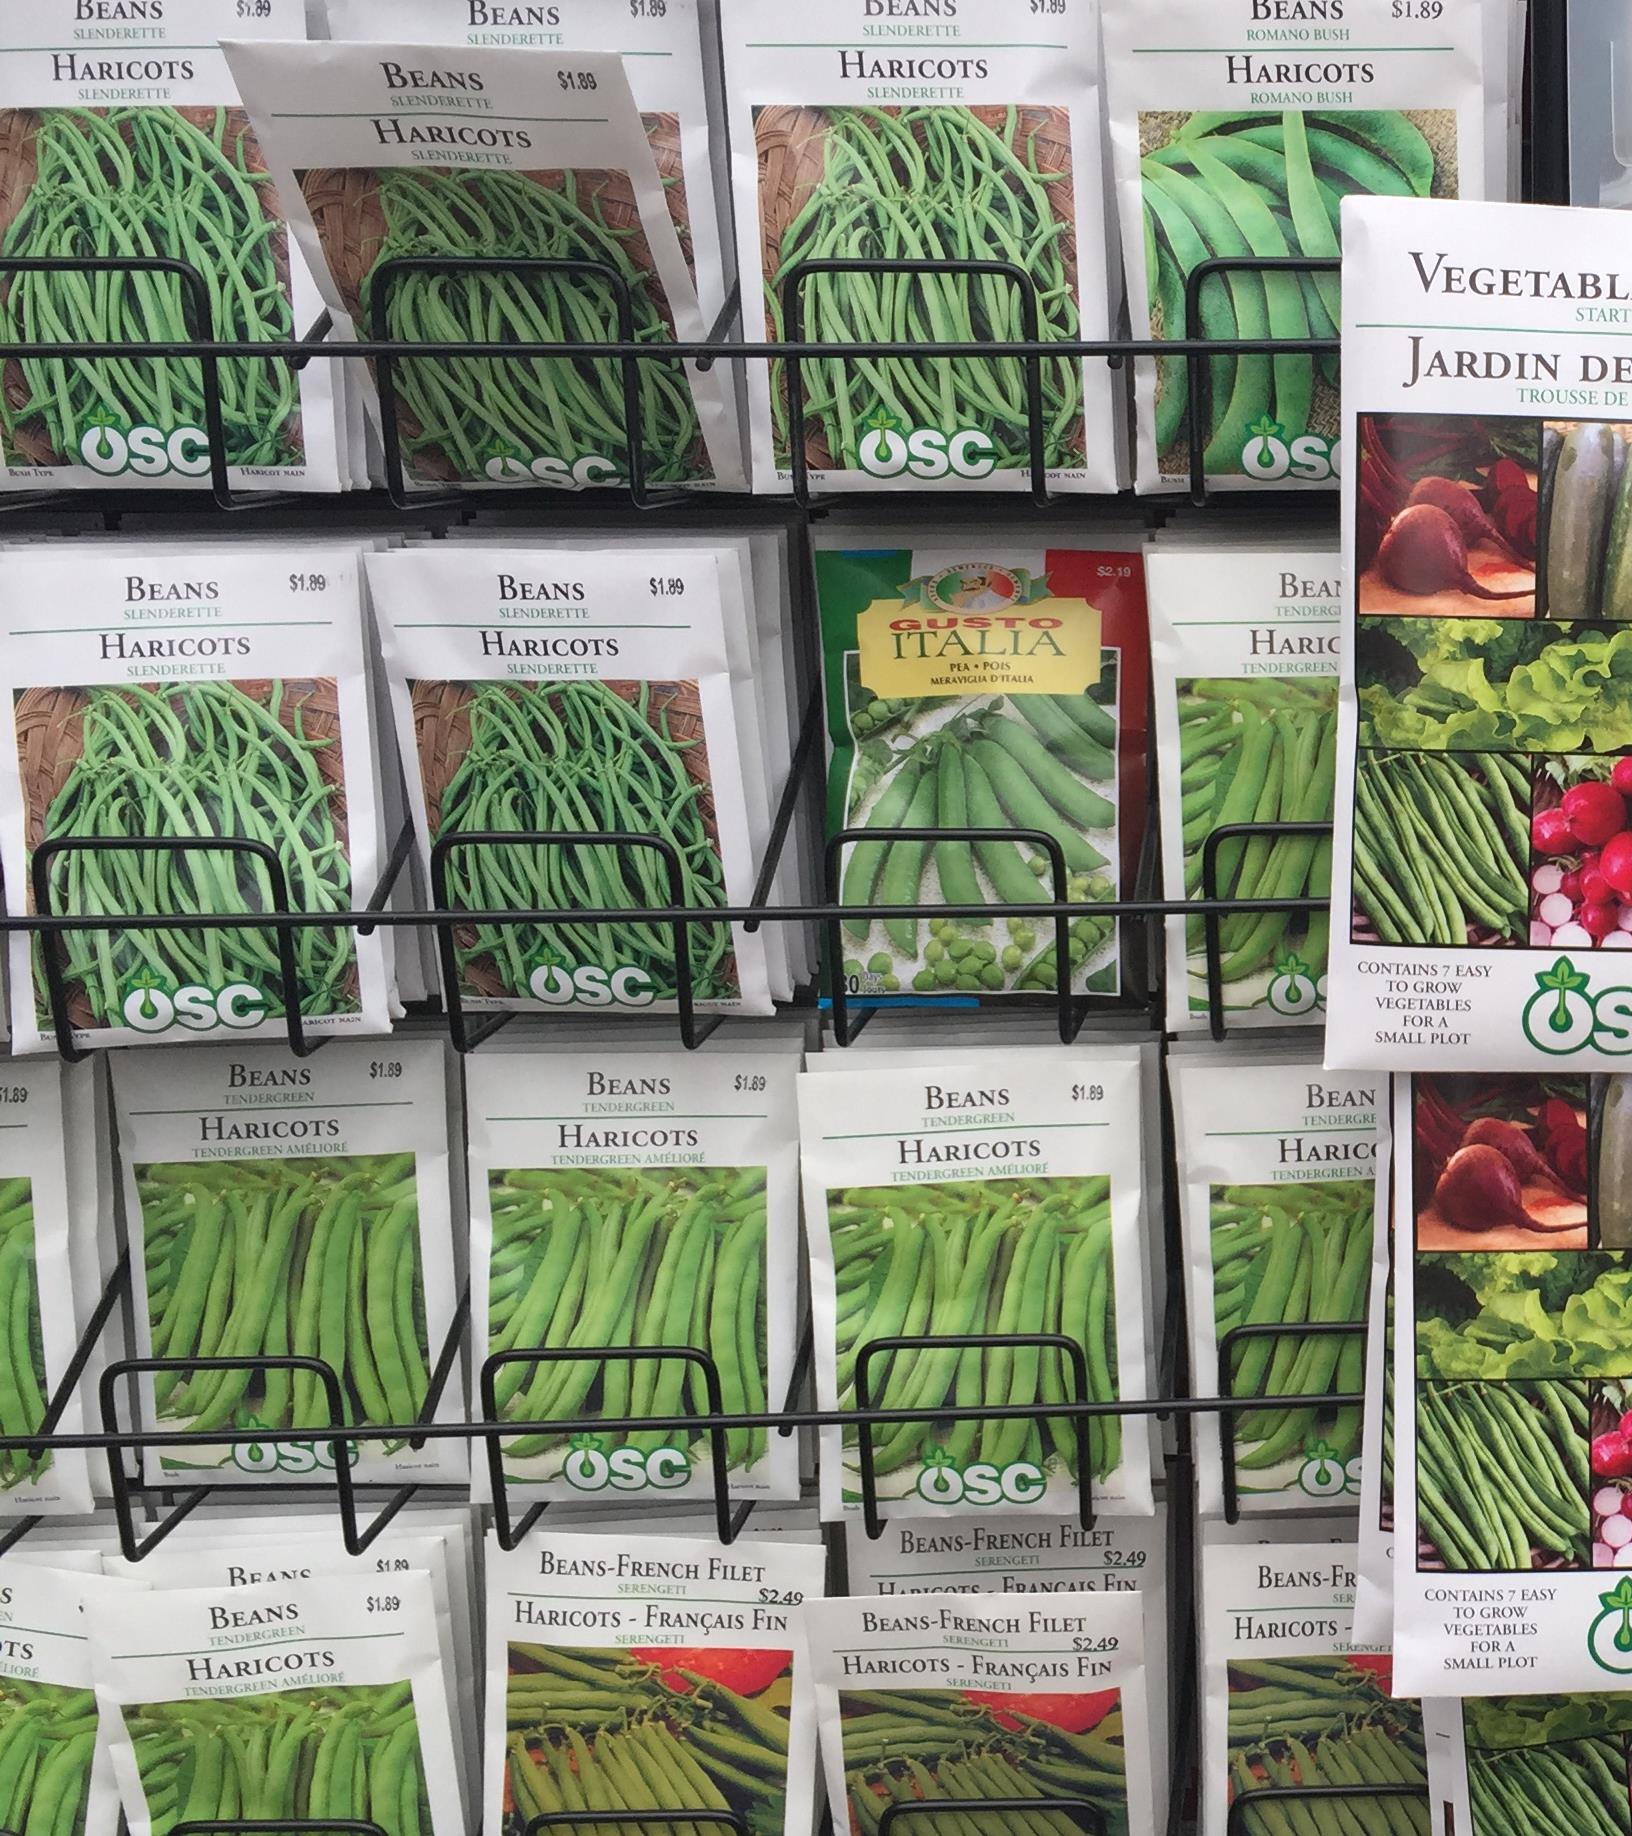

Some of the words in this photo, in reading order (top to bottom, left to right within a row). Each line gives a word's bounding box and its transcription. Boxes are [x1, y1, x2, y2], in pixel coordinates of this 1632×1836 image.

[1391, 1, 1443, 19] $1.89
[1247, 29, 1309, 41] ROMANO
[1314, 29, 1350, 41] BUSH
[51, 53, 194, 81] HARICOTS
[838, 50, 988, 79] HARICOTS
[1225, 55, 1374, 84] HARICOTS
[379, 62, 484, 91] BEANS
[557, 71, 597, 91] $1.89
[78, 88, 170, 100] SLENDERETTE
[370, 118, 532, 149] HARICOTS
[1403, 336, 1559, 389] JARDIN
[1516, 388, 1599, 406] TROUSSE
[1603, 390, 1630, 407] DE
[1096, 566, 1131, 578] $2.19
[125, 576, 219, 601] BEANS
[124, 607, 222, 620] SLENDERETTE
[889, 617, 1064, 631] GUSTO
[99, 633, 251, 660] HARICOTS
[891, 629, 1066, 660] ITALIA
[949, 662, 970, 672] PEA
[983, 661, 1011, 671] POIS
[1241, 662, 1337, 673] TENDERGREEN
[1357, 961, 1438, 976] CONTAINS
[1442, 965, 1450, 976] 7
[1456, 965, 1493, 977] EASY
[1386, 980, 1408, 993] TO
[1413, 981, 1463, 994] GROW
[121, 983, 268, 1032] OSC
[1375, 996, 1472, 1012] VEGETABLES
[1402, 1015, 1433, 1028] FOR
[1438, 1016, 1449, 1028] A
[1375, 1030, 1425, 1045] SMALL
[1430, 1033, 1471, 1045] PLOT
[228, 1063, 312, 1088] BEANS
[369, 1061, 402, 1079] $1.89
[925, 1085, 1010, 1110] BEANS
[1072, 1084, 1104, 1101] $1.89
[199, 1116, 340, 1141] HARICOTS
[192, 1145, 283, 1159] TENDERGREEN
[286, 1141, 348, 1154] AMÉLIORÉ
[898, 1139, 1041, 1164] HARICOTS
[563, 1447, 691, 1491] OSC
[539, 1551, 699, 1579] BEANS-FRENCH
[708, 1558, 765, 1582] FILET
[618, 1583, 687, 1595] SERENGETI
[759, 1588, 804, 1605] $2.49
[367, 1596, 399, 1612] $1.89
[209, 1603, 299, 1630] BEANS
[515, 1601, 621, 1627] HARICOTS
[645, 1605, 744, 1635] FRANÇAIS
[752, 1608, 787, 1631] FIN
[862, 1609, 1020, 1633] BEANS-FRENCH
[1029, 1612, 1087, 1633] FILET
[1234, 1616, 1338, 1640] HARICOTS
[1444, 1623, 1537, 1636] VEGETABLES
[186, 1651, 335, 1681] HARICOTS
